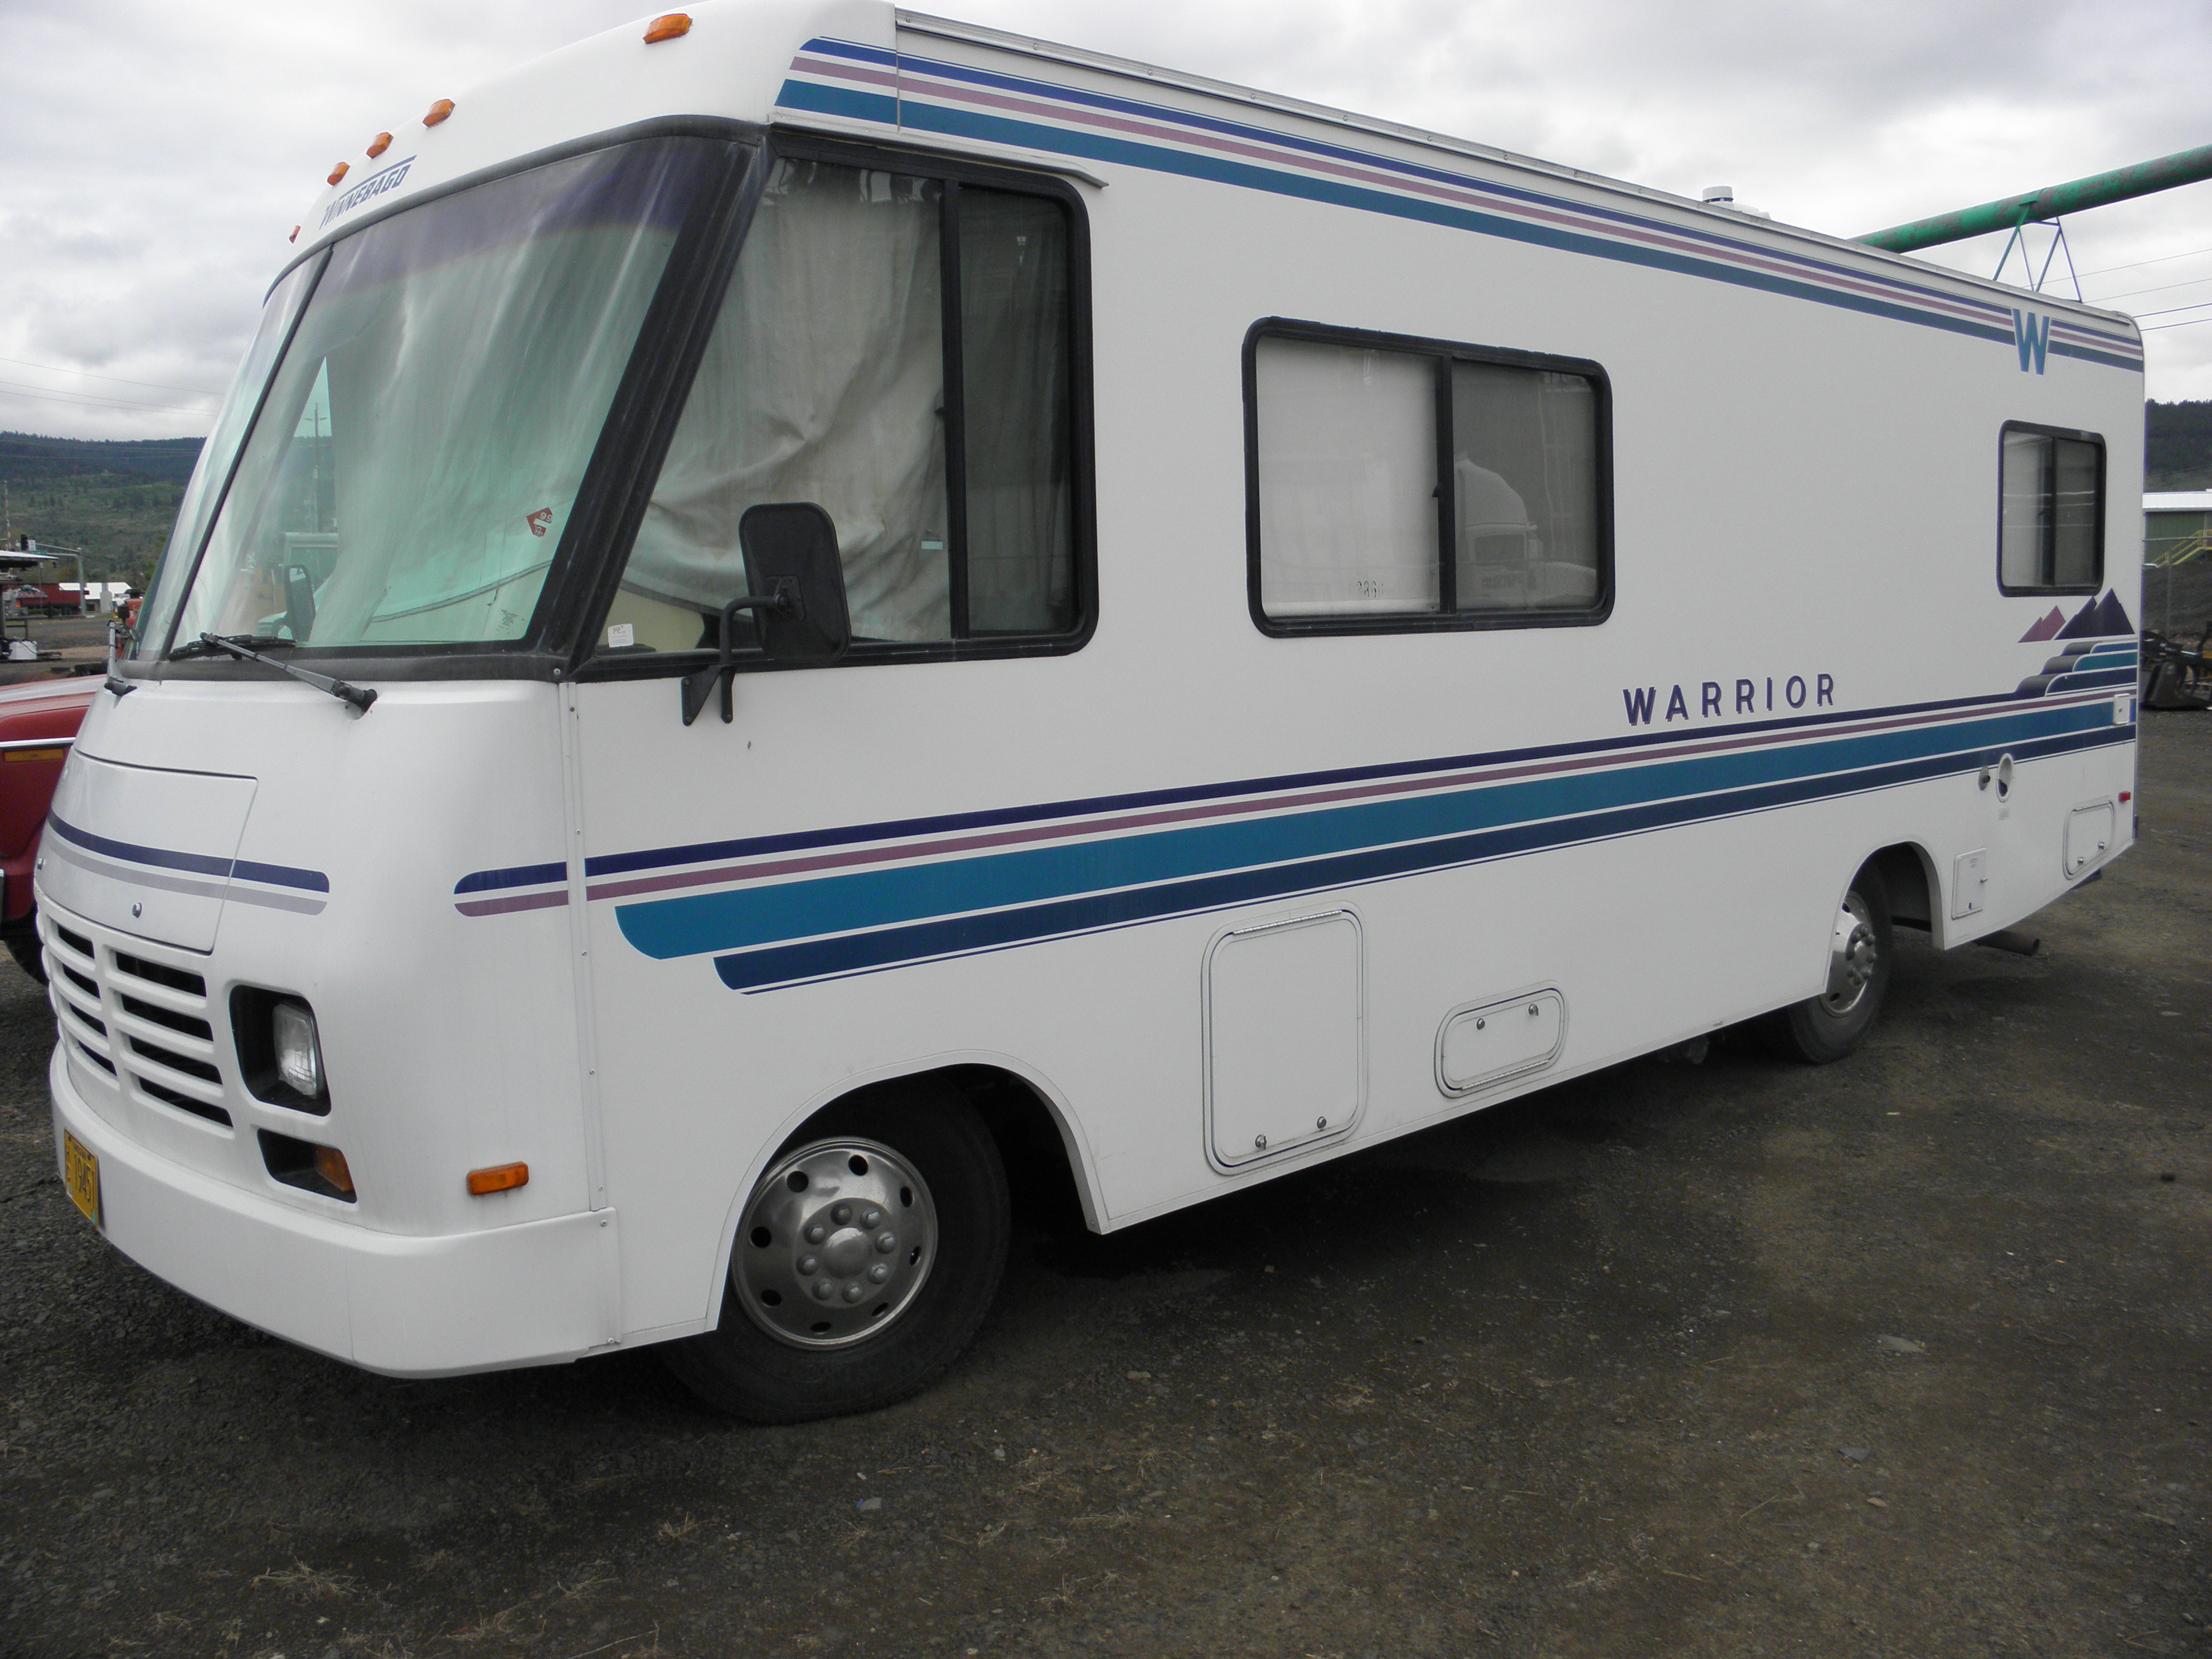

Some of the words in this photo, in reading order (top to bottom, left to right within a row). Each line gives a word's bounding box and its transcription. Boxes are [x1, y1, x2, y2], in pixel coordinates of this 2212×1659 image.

[319, 164, 411, 230] WINNEBAGO
[2012, 308, 2050, 375] W
[1623, 673, 1834, 726] WARRIOR
